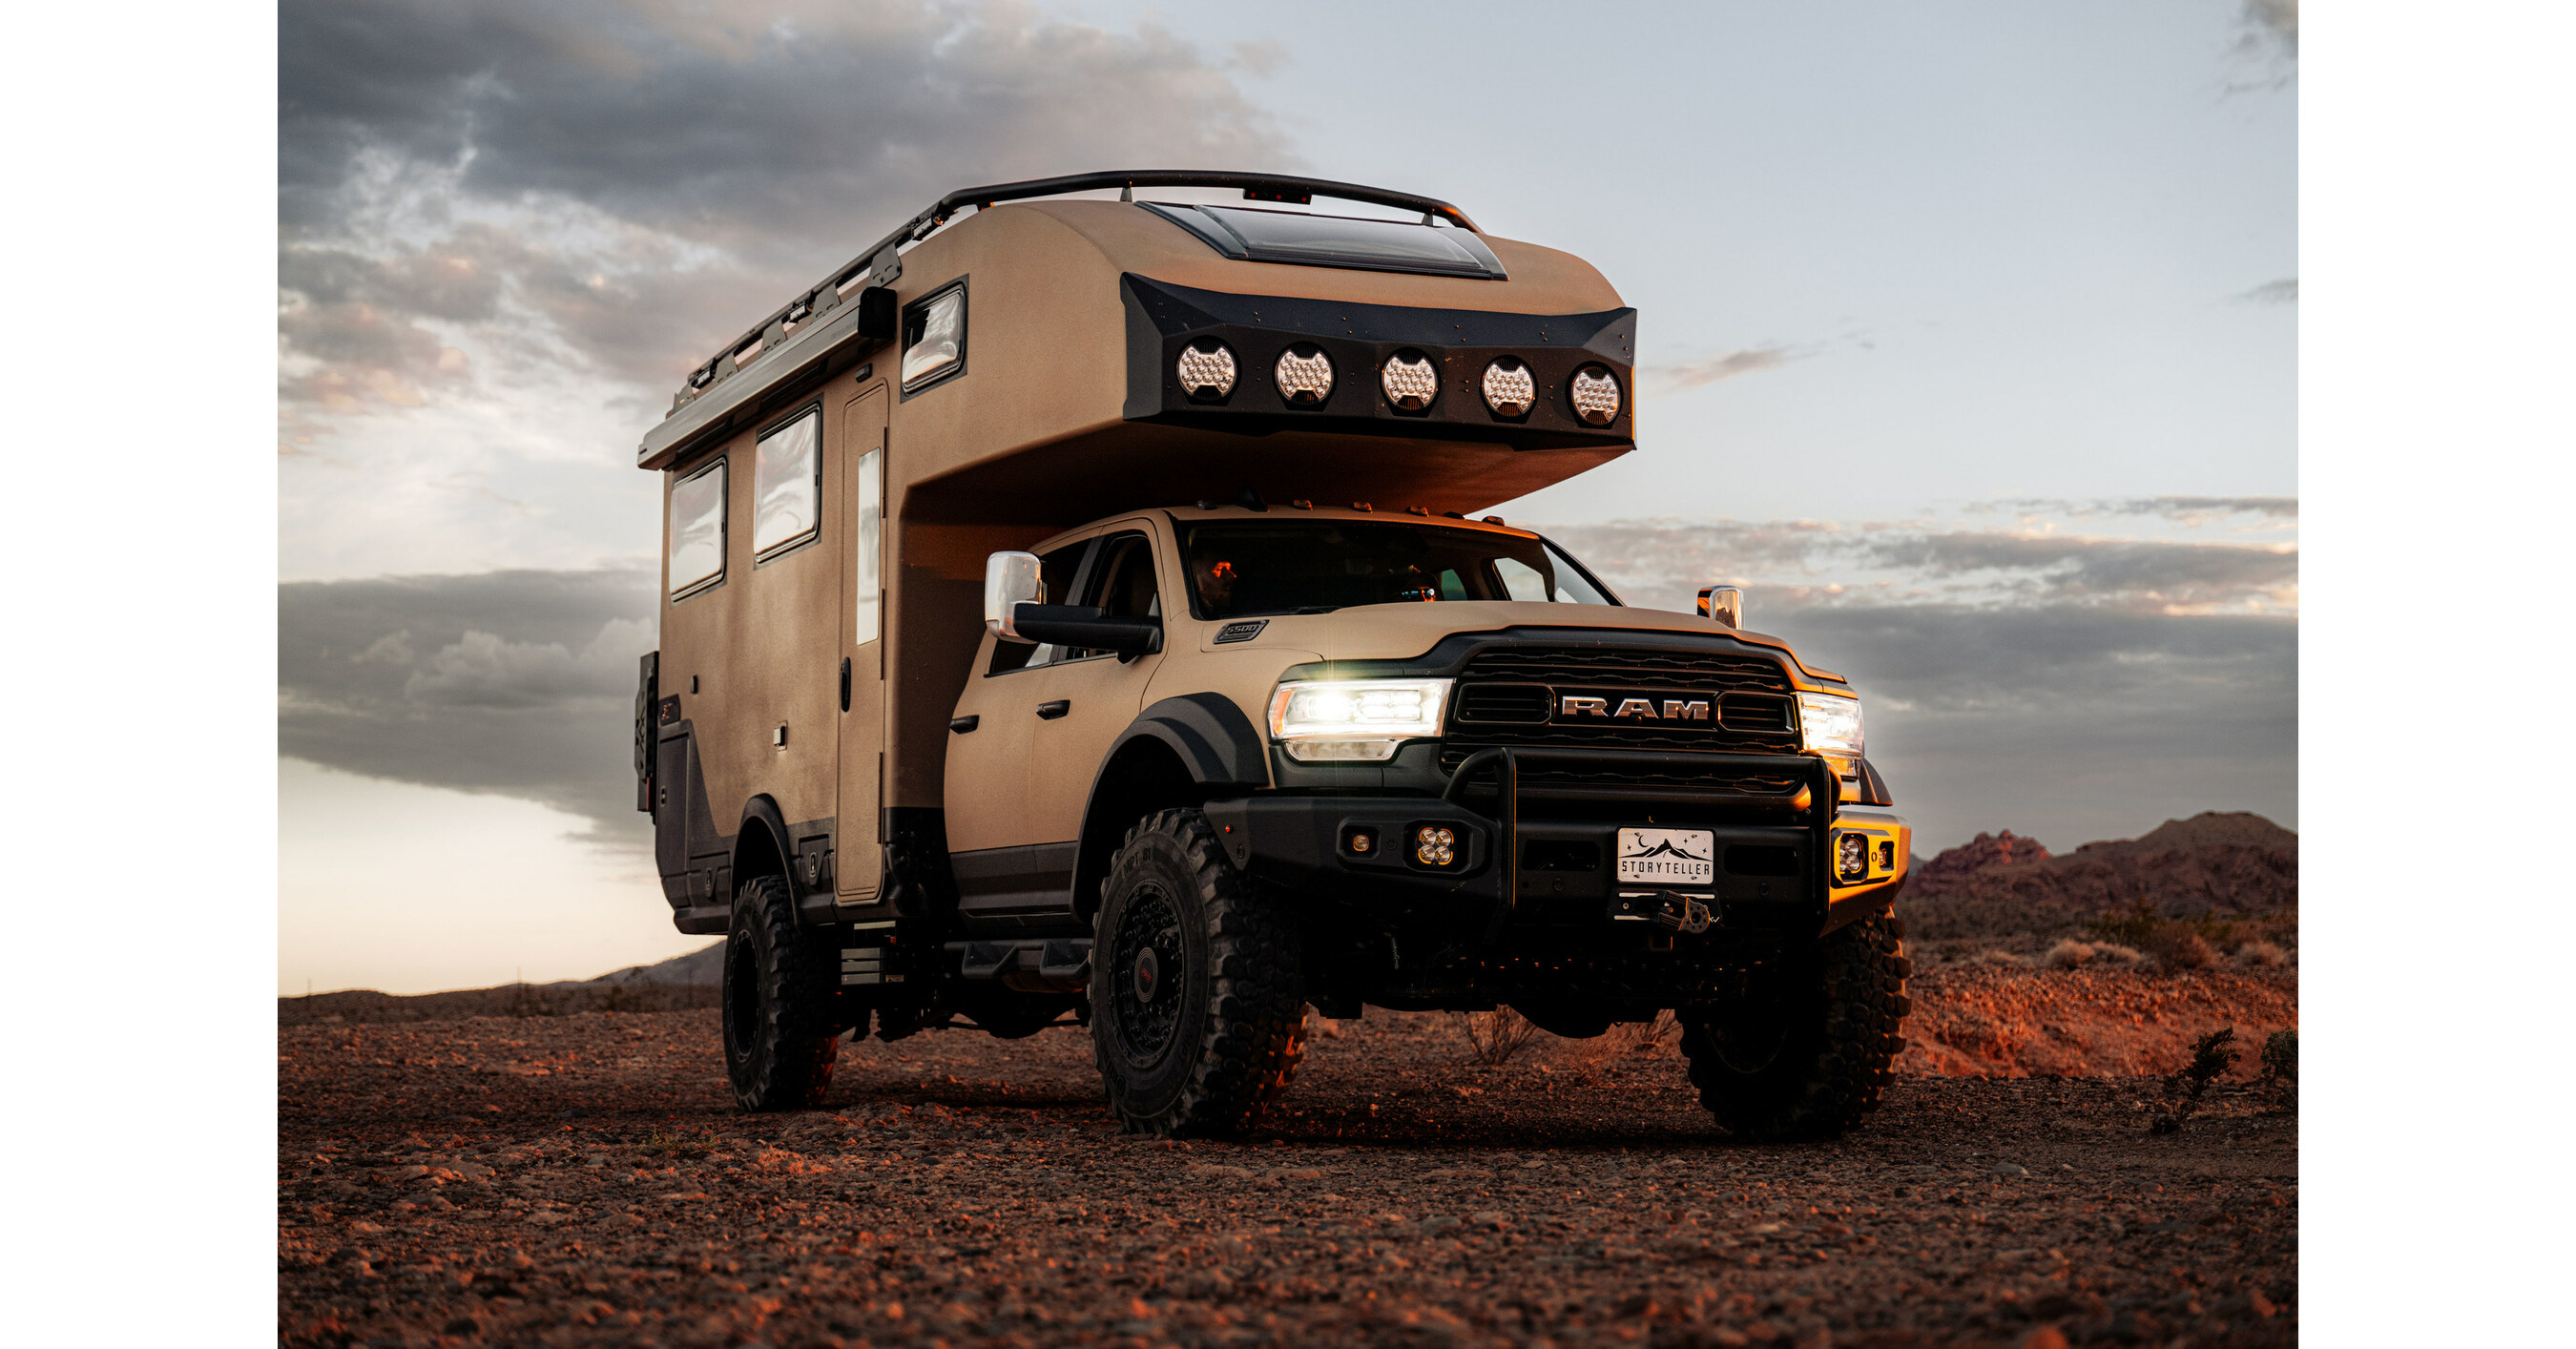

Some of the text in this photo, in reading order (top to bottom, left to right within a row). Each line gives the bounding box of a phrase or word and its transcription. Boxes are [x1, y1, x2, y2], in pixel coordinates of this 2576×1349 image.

[1227, 625, 1257, 634] 5500
[1562, 695, 1709, 720] RAM
[1123, 847, 1151, 876] MPT 81
[1622, 861, 1710, 875] STORYTELLER
